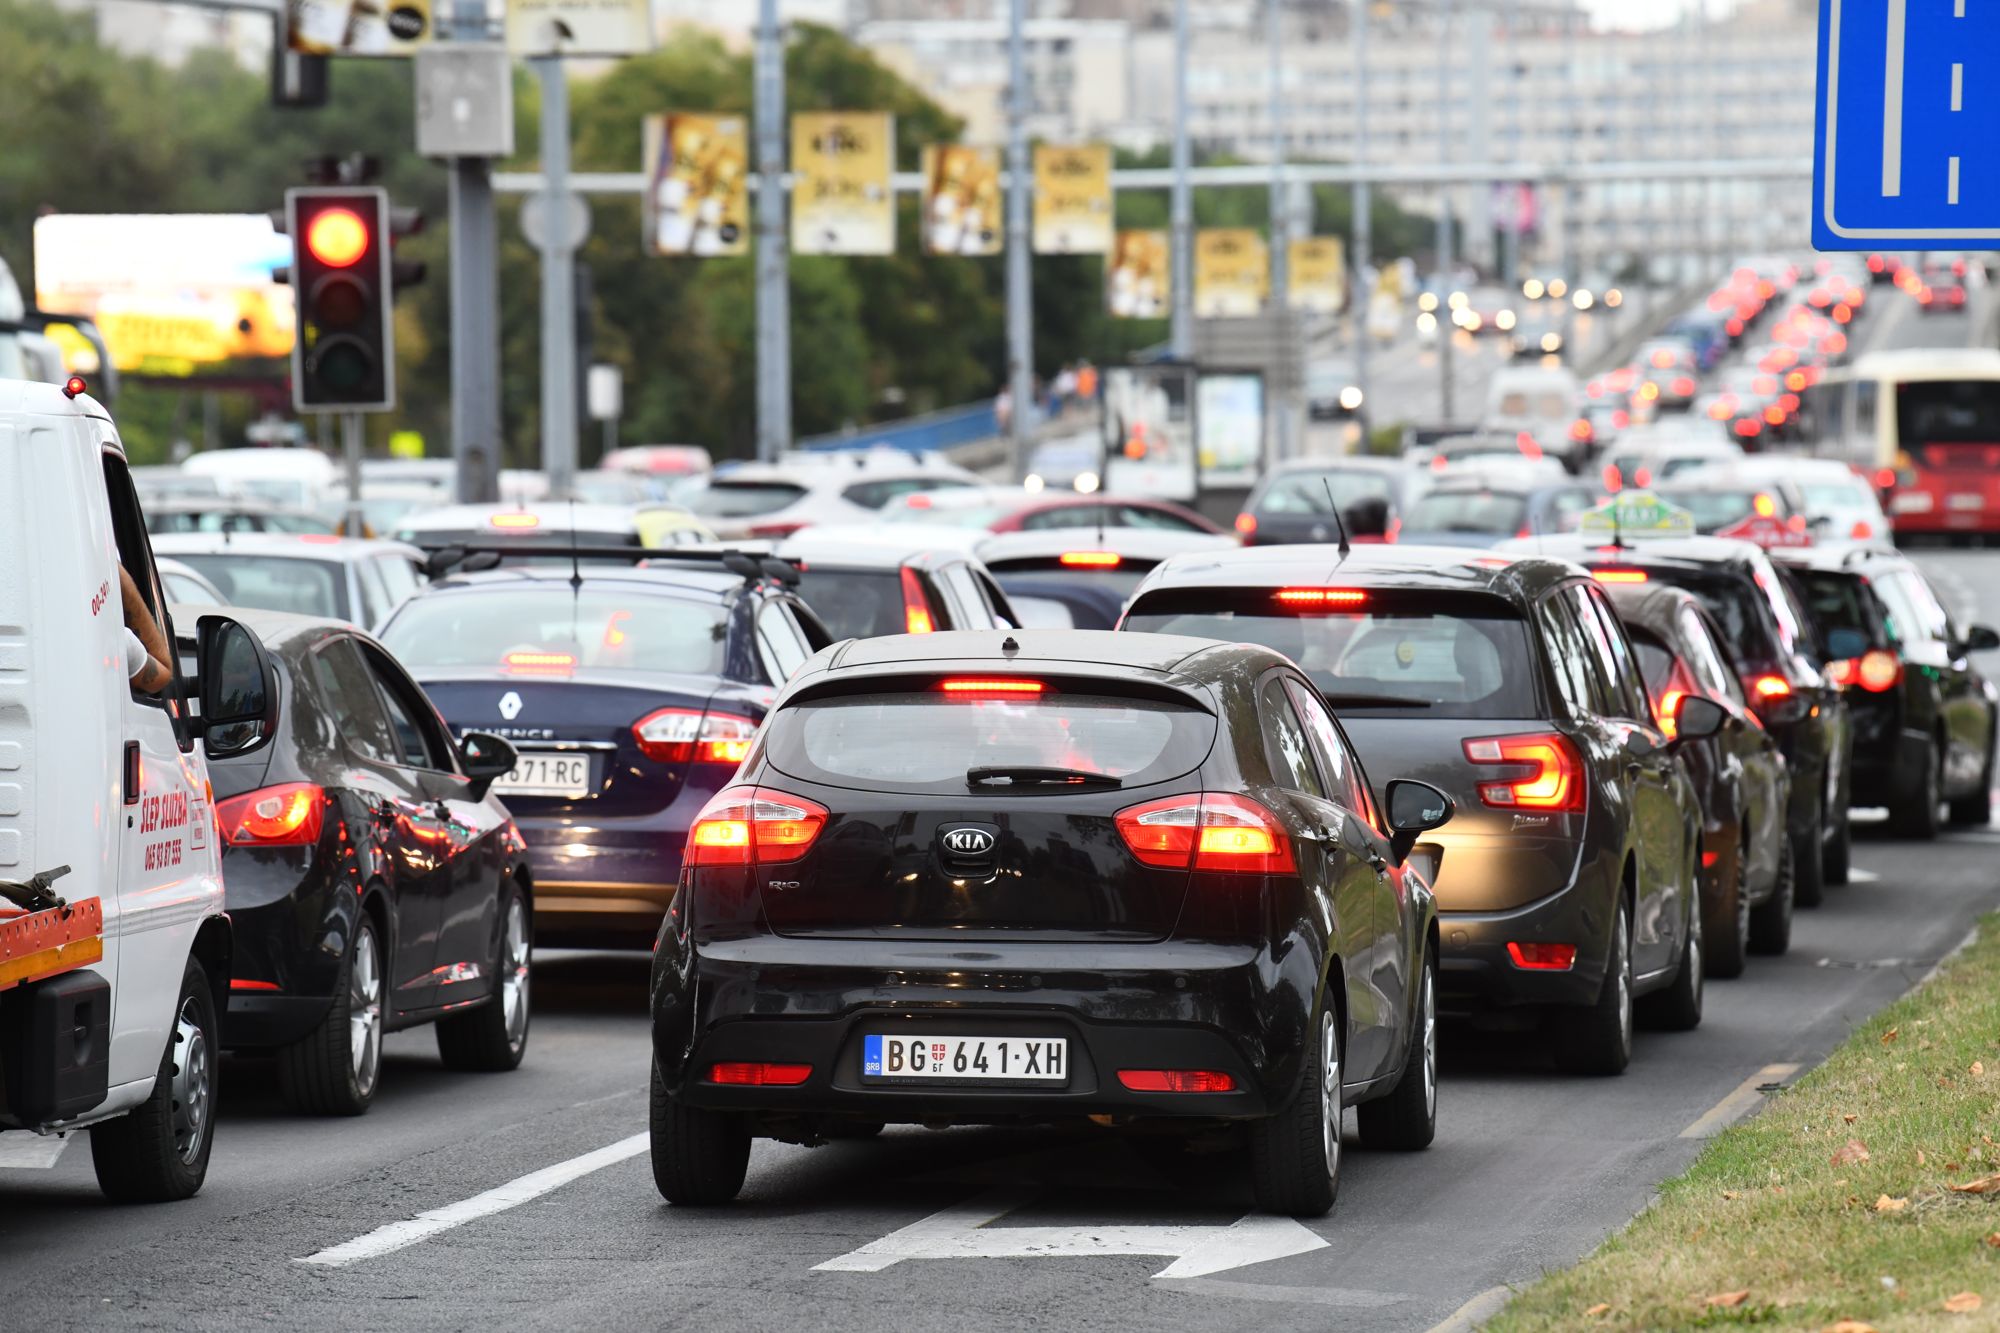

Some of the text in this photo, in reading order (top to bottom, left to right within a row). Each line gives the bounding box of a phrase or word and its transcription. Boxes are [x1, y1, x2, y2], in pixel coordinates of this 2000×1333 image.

[1617, 506, 1659, 523] TAXI
[951, 834, 986, 849] KIA
[769, 880, 800, 891] RIO
[888, 1040, 926, 1072] BG
[865, 1062, 880, 1071] SRB
